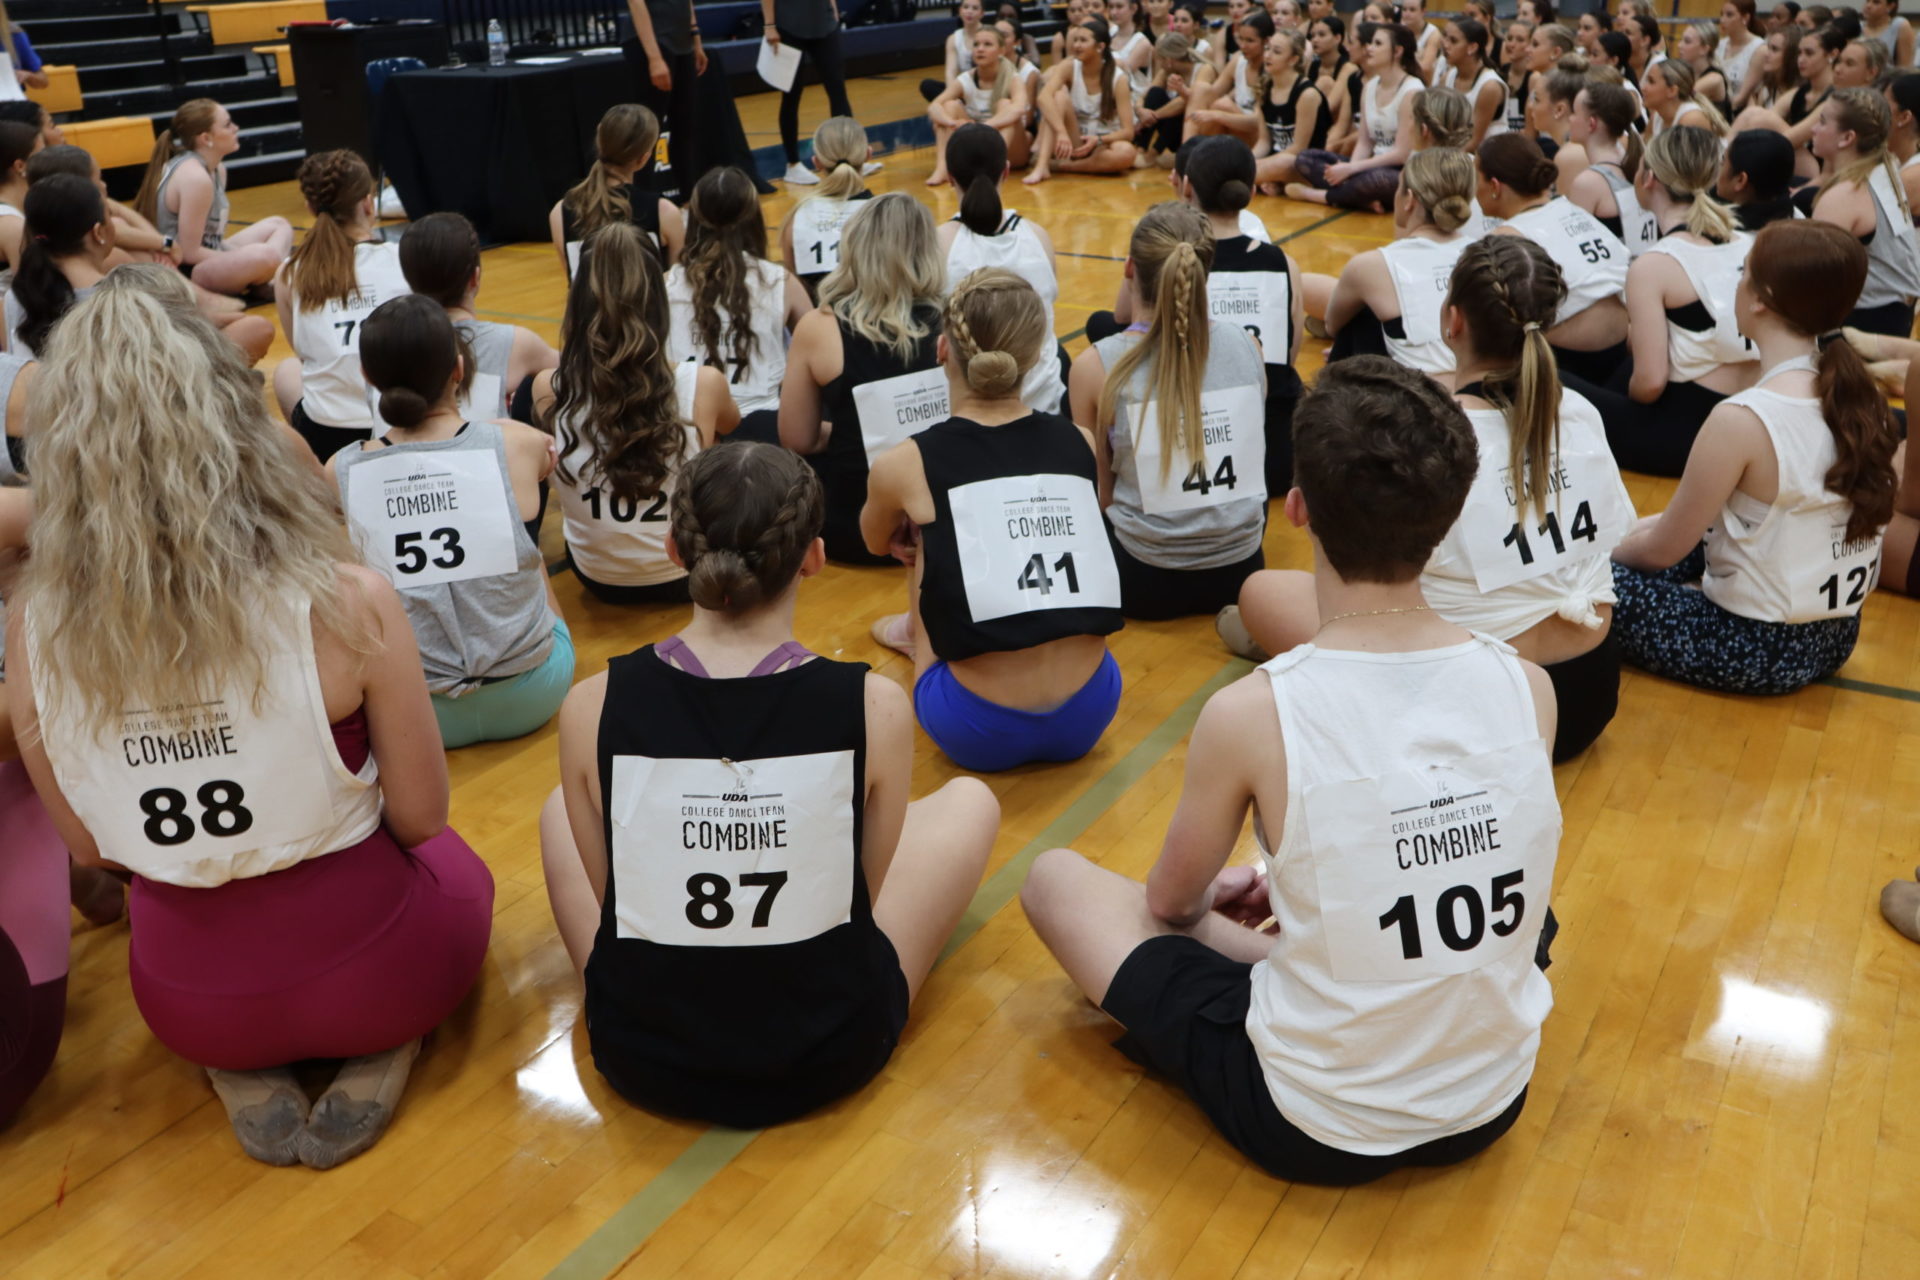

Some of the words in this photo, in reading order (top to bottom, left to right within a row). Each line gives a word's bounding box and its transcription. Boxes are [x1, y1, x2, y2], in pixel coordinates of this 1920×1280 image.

[1578, 238, 1611, 264] 55
[1211, 299, 1261, 316] COMBINE
[896, 398, 949, 425] COMBINE
[384, 484, 412, 497] COLLEGE
[437, 479, 455, 488] TEAM
[1182, 454, 1238, 496] 44
[386, 490, 459, 519] COMBINE
[1007, 515, 1076, 540] COMBINE
[1503, 500, 1598, 566] 114
[395, 526, 466, 575] 53
[1017, 551, 1080, 596] 41
[122, 725, 238, 768] COMBINE
[138, 779, 254, 847] 88
[681, 805, 725, 818] COLLEGE
[728, 807, 758, 819] DANCE
[760, 805, 785, 817] TEAM
[721, 793, 749, 803] UDA
[1429, 795, 1455, 809] UDA
[1392, 816, 1437, 835] COLLEGE
[1439, 808, 1468, 824] DANCE
[1469, 803, 1494, 818] TEAM
[682, 819, 788, 852] COMBINE
[1395, 817, 1501, 870] COMBINE
[685, 870, 789, 930] 87
[1378, 867, 1526, 961] 105
